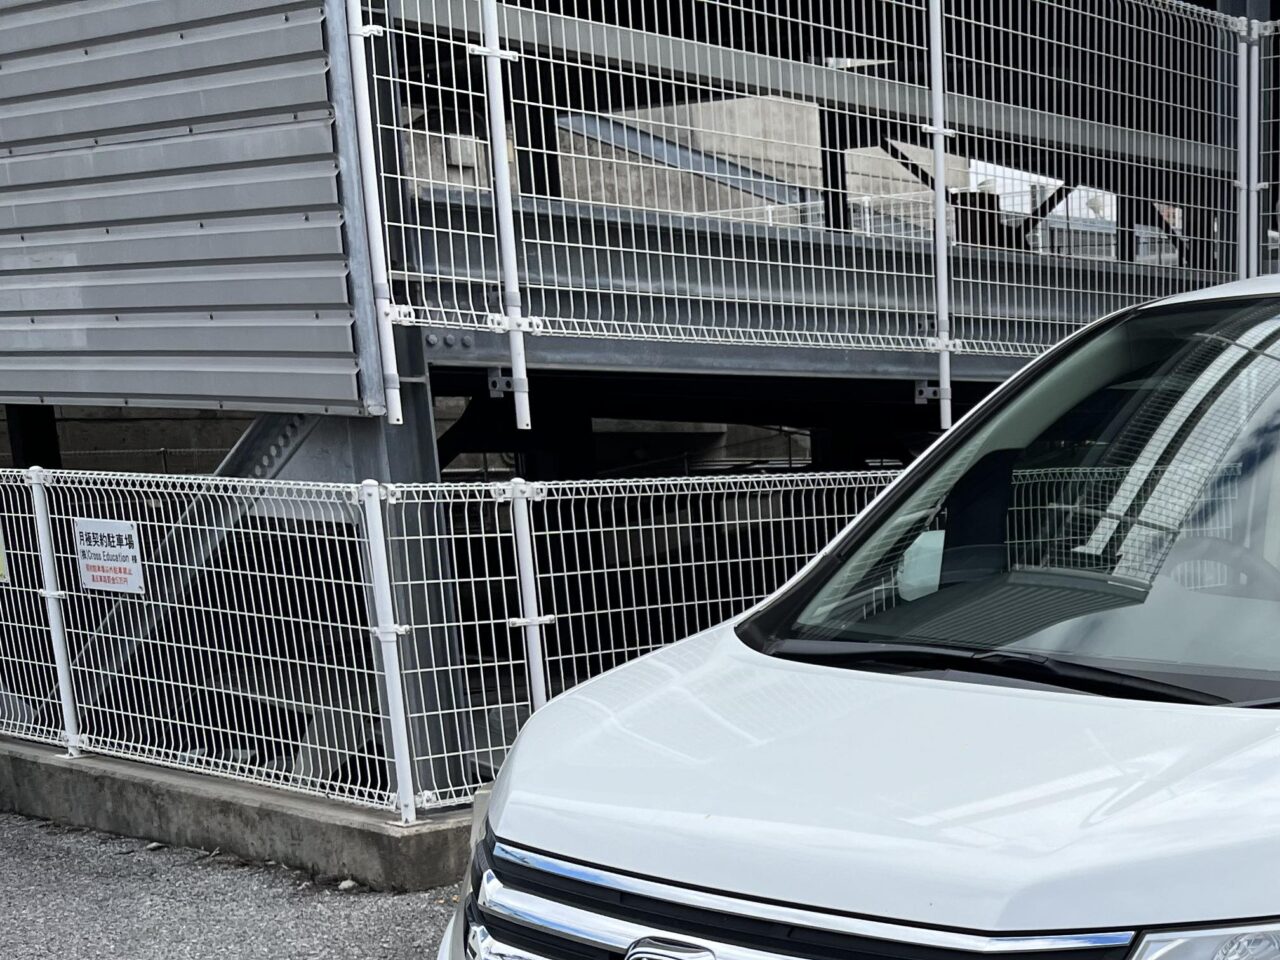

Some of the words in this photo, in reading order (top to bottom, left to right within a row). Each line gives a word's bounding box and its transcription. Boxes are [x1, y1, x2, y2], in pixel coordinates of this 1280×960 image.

[79, 531, 135, 549] 月極契約駐車場
[102, 551, 129, 562] Education
